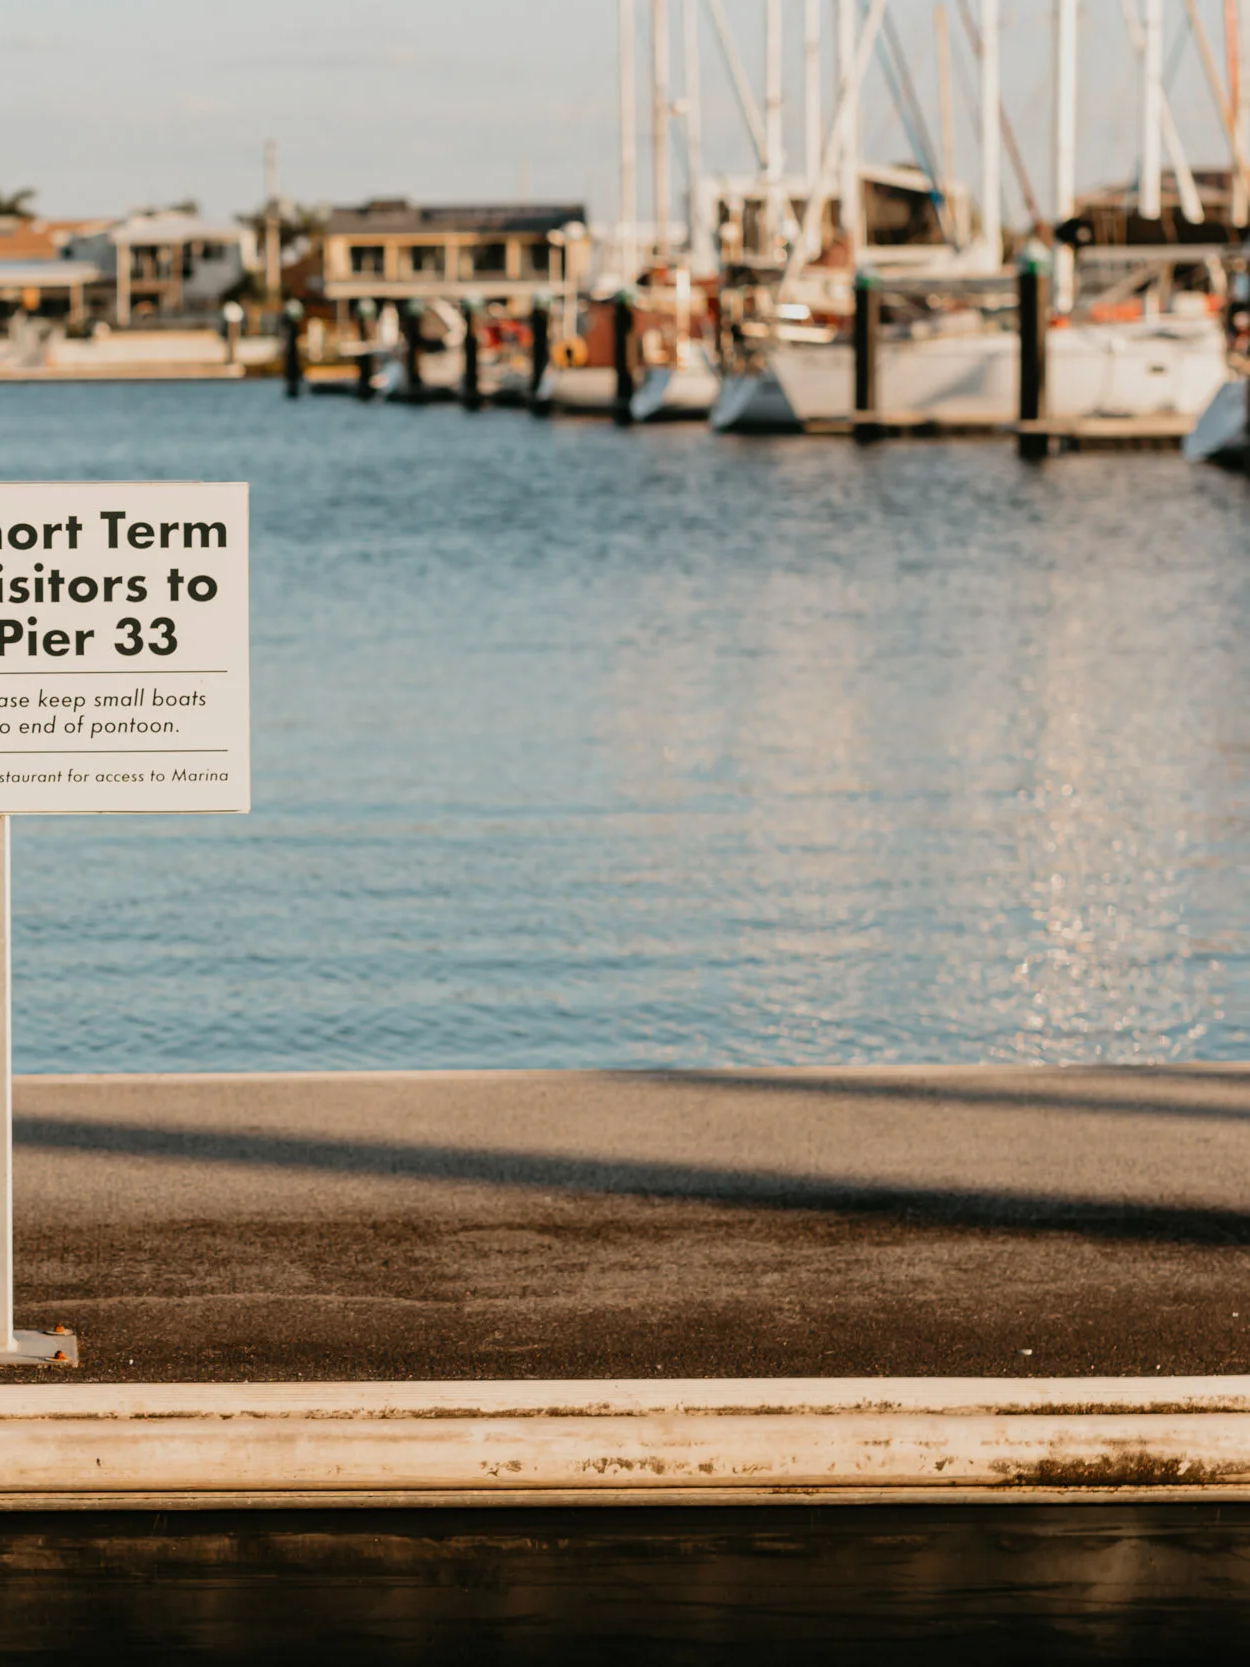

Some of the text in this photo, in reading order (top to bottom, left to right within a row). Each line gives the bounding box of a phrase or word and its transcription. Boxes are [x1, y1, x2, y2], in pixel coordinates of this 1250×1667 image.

[100, 511, 227, 549] Term
[167, 568, 218, 602] to
[114, 617, 178, 657] 33
[38, 688, 86, 712] keep
[94, 688, 145, 707] small
[152, 687, 207, 707] boats
[19, 715, 56, 734] end
[64, 714, 85, 734] of
[90, 717, 179, 739] pontoon.
[67, 769, 89, 783] for
[95, 770, 144, 783] access
[150, 769, 165, 782] to
[171, 768, 229, 782] Marina
